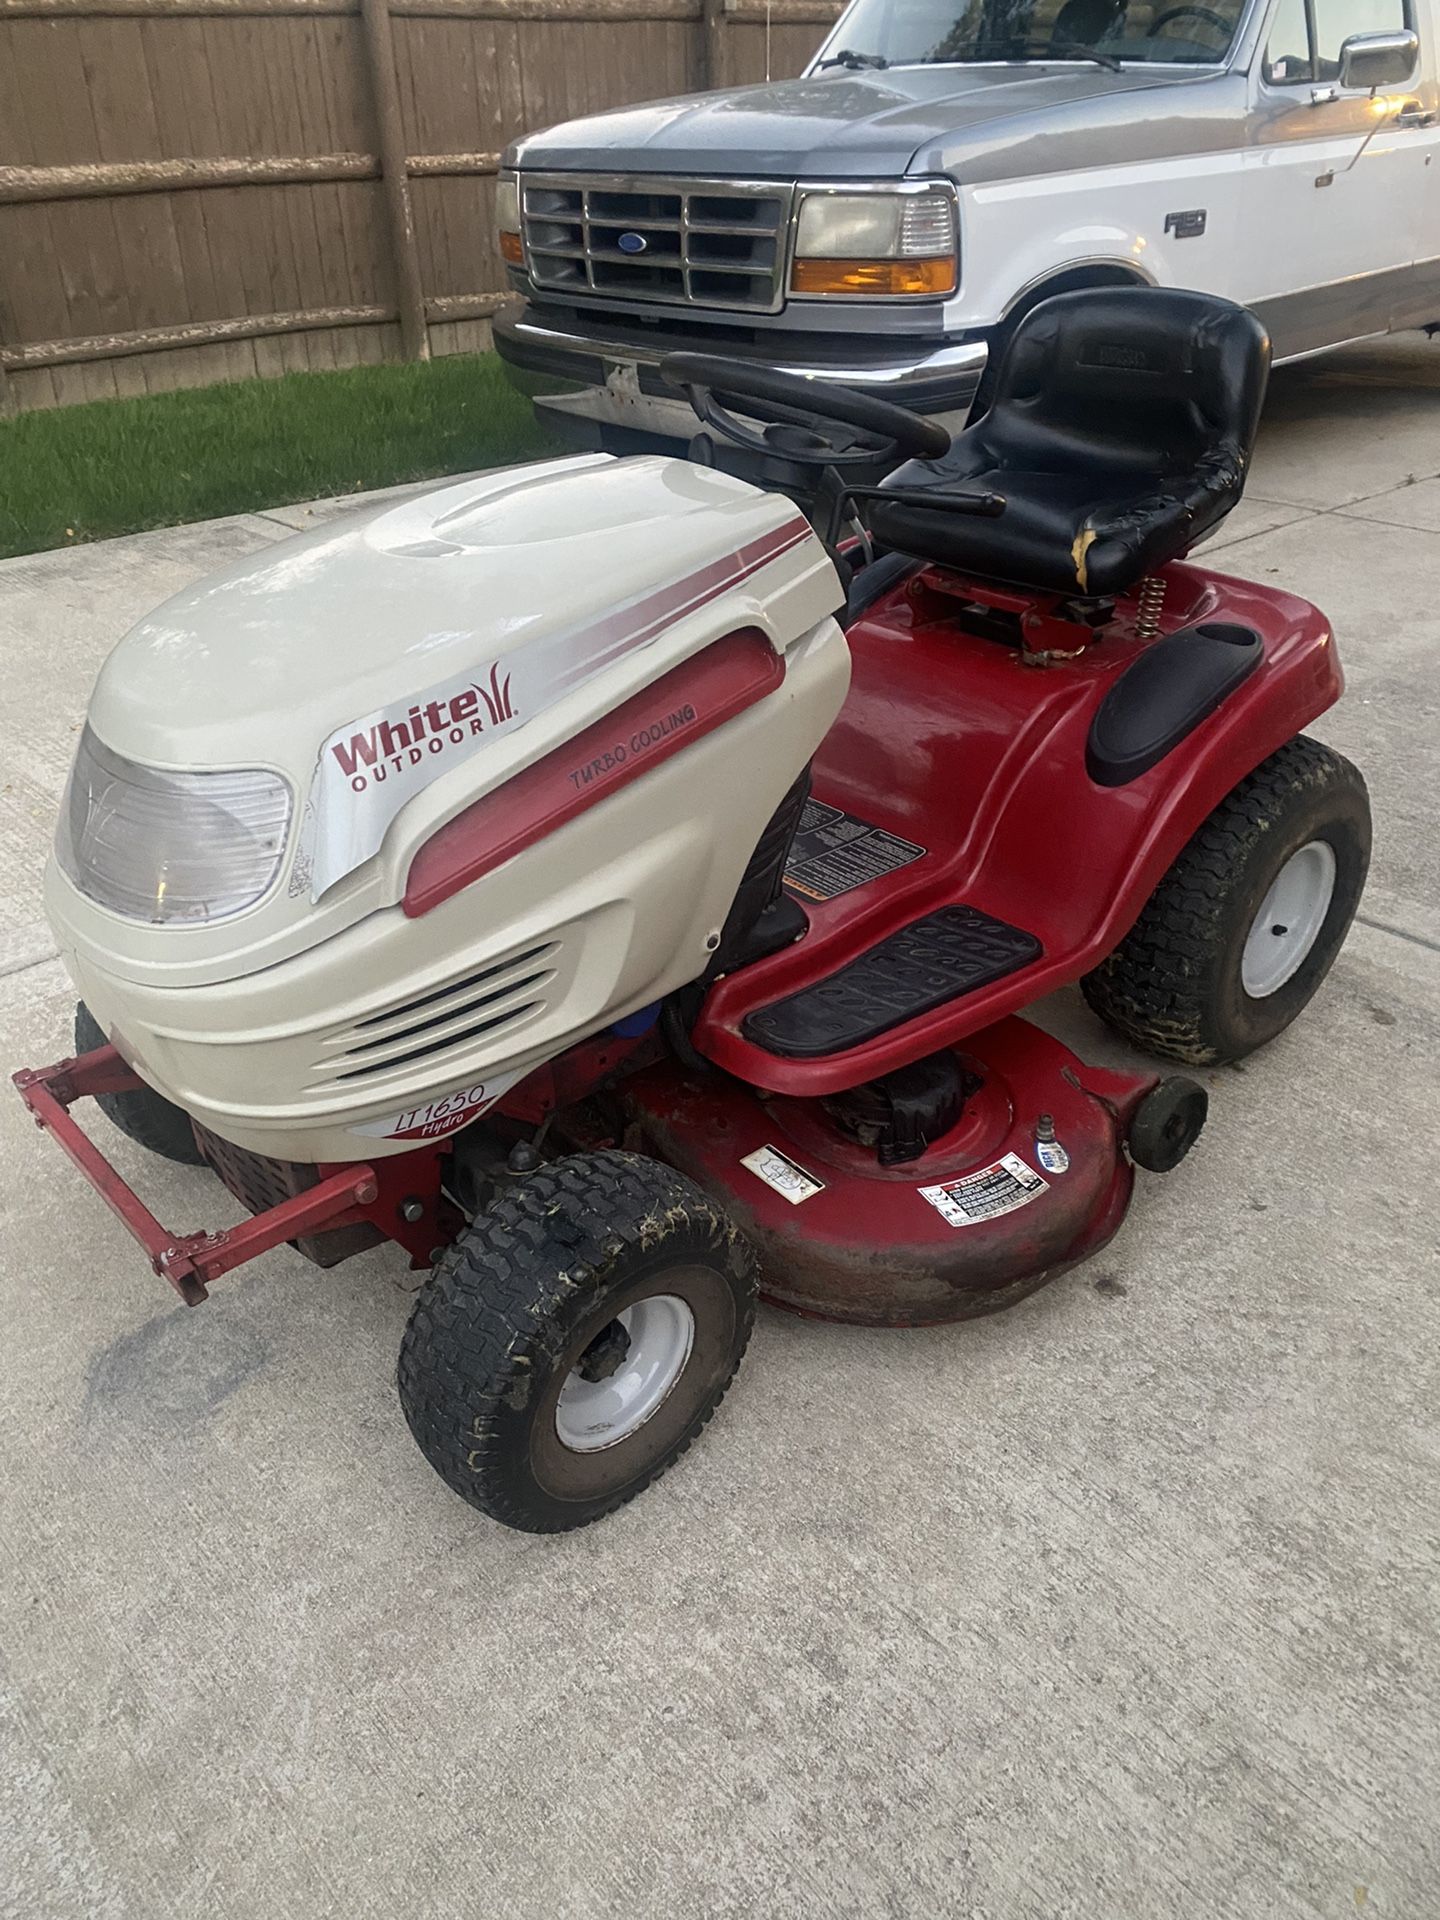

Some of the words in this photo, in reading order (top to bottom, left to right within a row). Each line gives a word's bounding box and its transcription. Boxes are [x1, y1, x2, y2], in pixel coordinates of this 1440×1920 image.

[332, 690, 479, 776] White
[351, 718, 484, 792] OUTDOOR
[570, 746, 626, 789] TURBO
[631, 704, 696, 753] COOLING
[395, 1108, 421, 1132] LT
[425, 1084, 485, 1122] 1650
[421, 1113, 464, 1137] Hydro
[960, 1169, 993, 1186] DANGER
[1041, 1151, 1054, 1167] DECK
